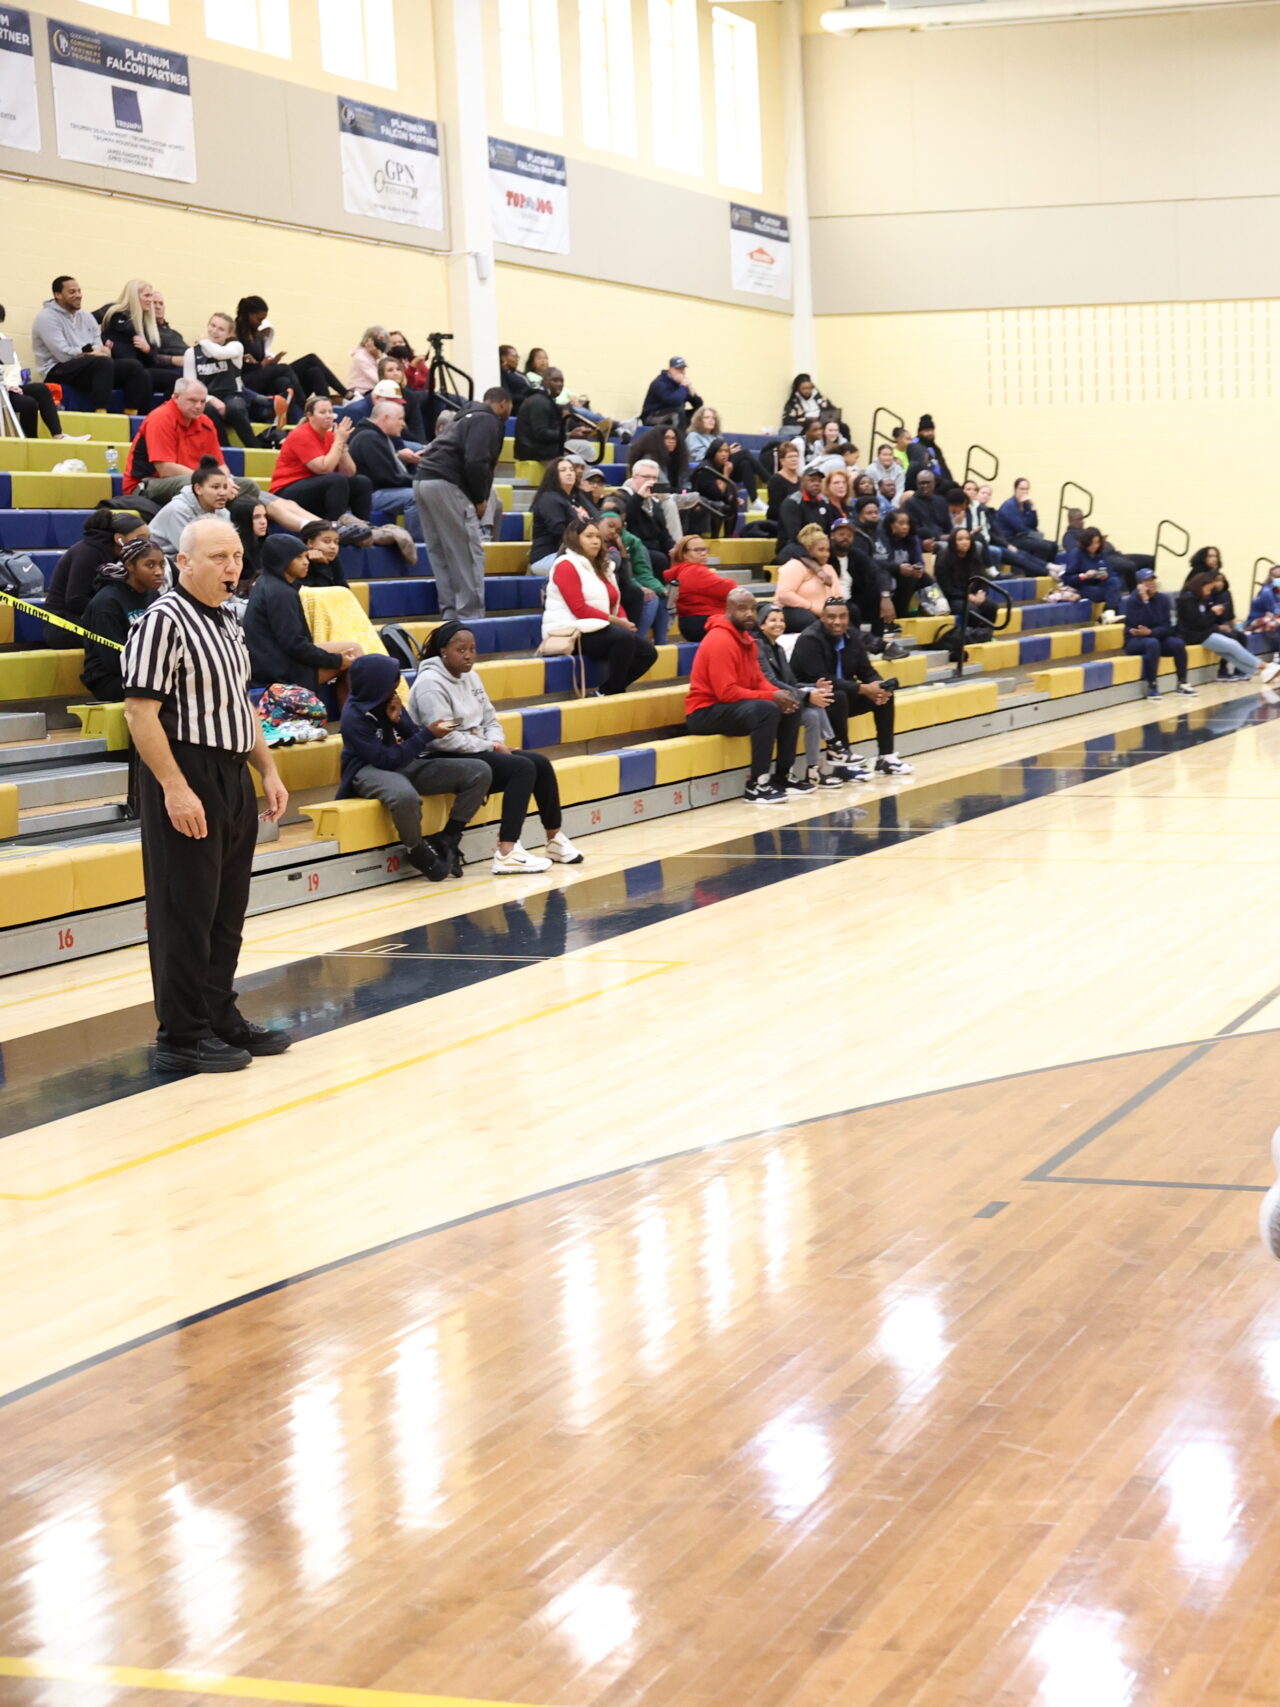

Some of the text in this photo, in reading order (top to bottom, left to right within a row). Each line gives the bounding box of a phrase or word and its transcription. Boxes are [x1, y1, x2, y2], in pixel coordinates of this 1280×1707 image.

[125, 48, 170, 70] PLATINUM
[106, 56, 188, 87] FALCON PARTNER
[13, 600, 50, 621] CAUTION
[591, 809, 602, 824] 24
[633, 799, 644, 814] 25
[386, 856, 400, 873] 20
[307, 872, 320, 892] 19
[58, 928, 74, 950] 16
